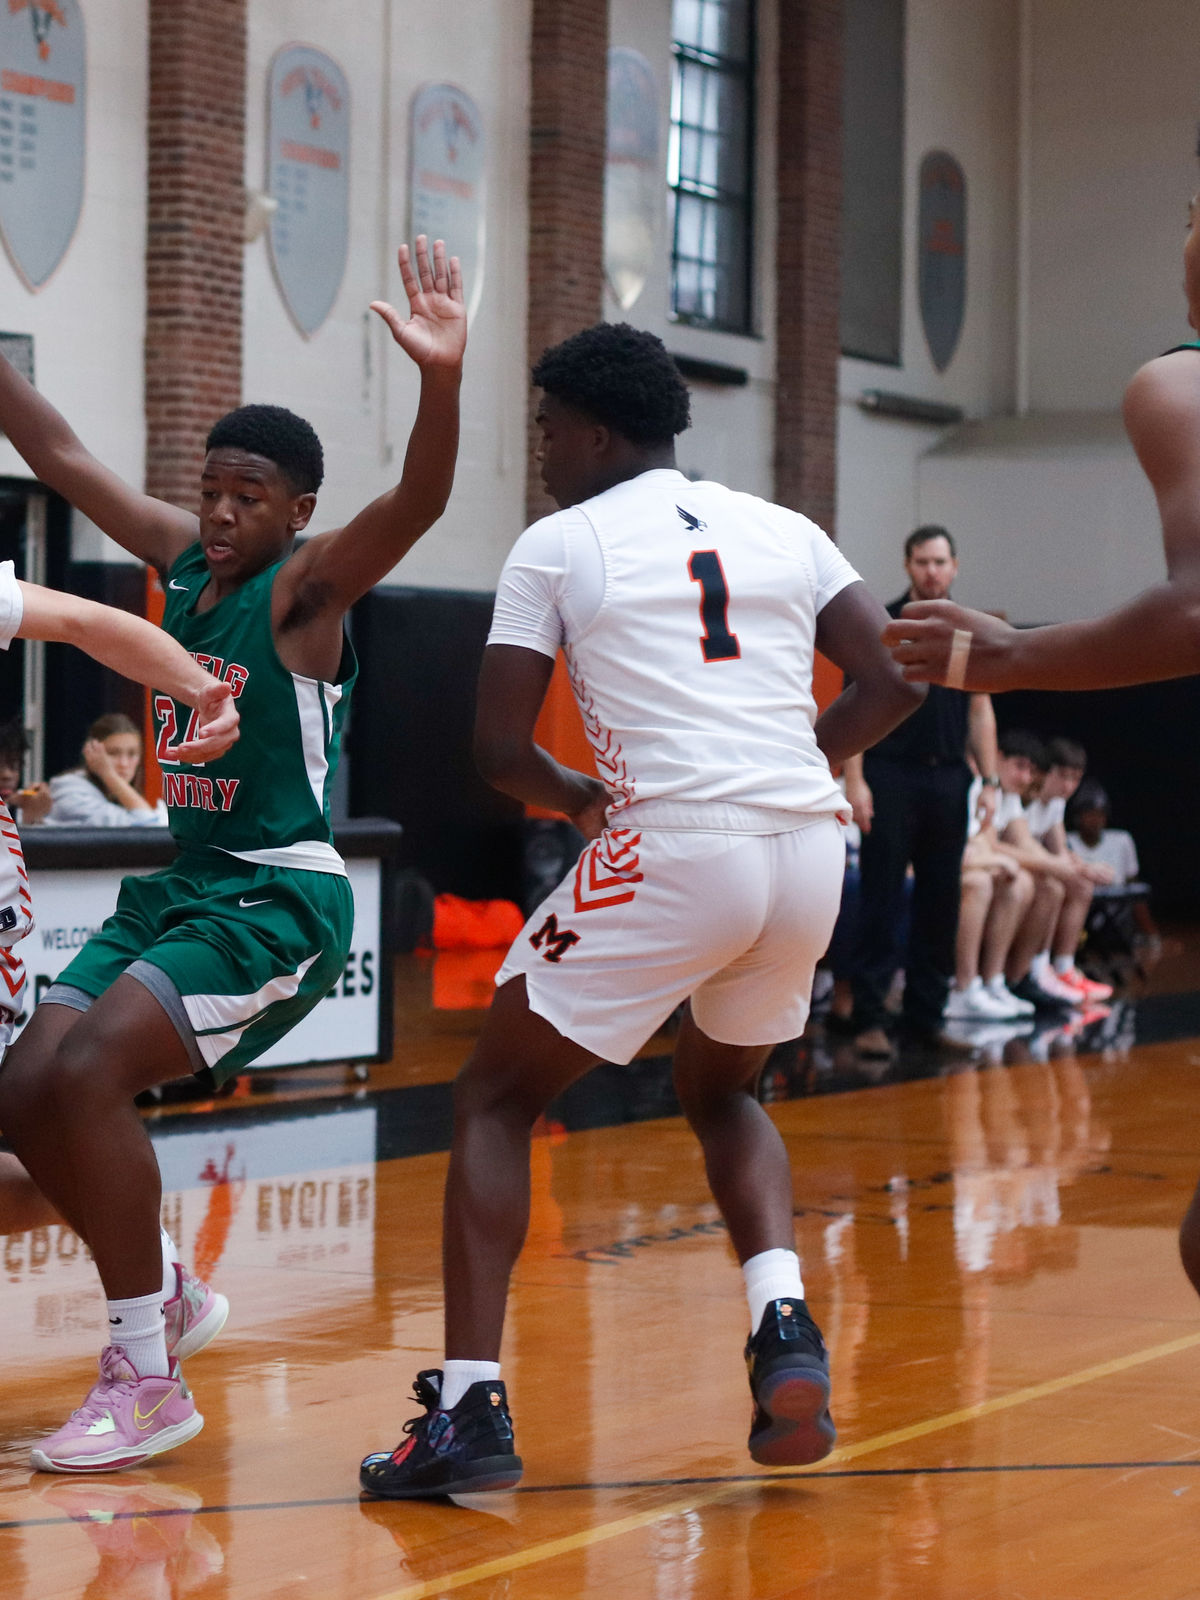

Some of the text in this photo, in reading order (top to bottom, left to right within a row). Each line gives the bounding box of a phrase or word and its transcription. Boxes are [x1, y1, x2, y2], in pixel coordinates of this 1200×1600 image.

[687, 549, 741, 663] 1
[163, 773, 240, 812] NTRY
[528, 912, 581, 963] M
